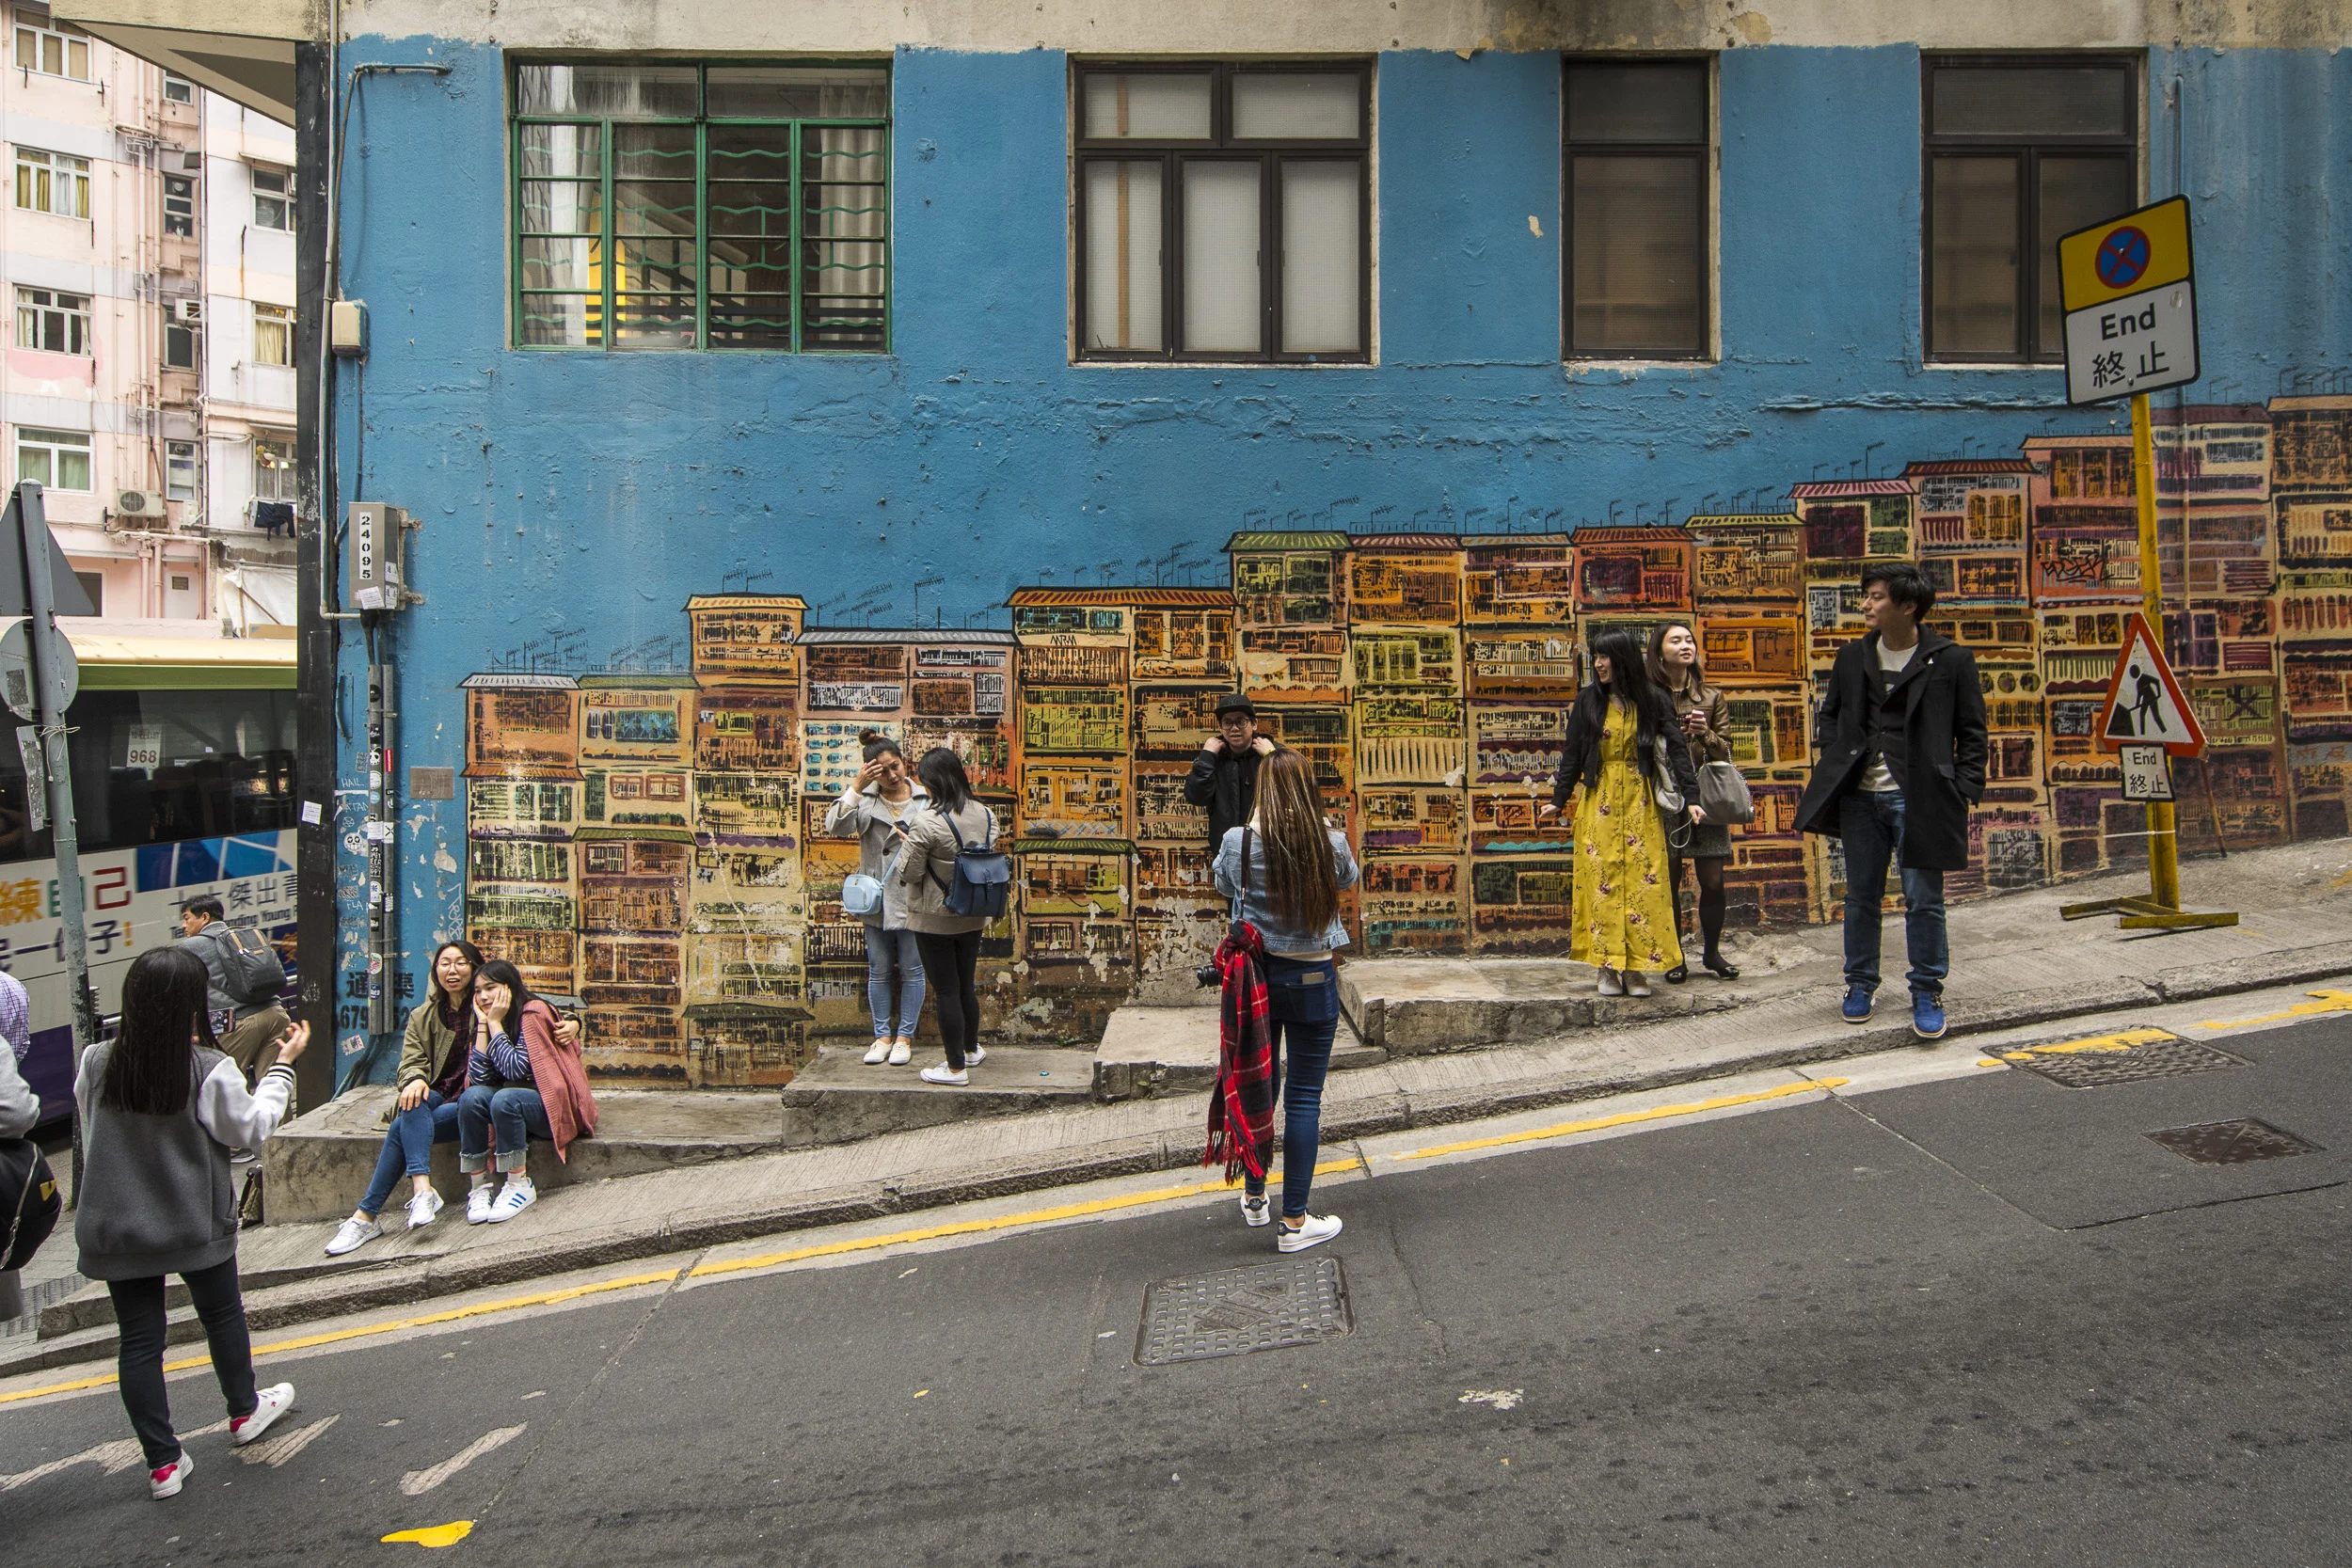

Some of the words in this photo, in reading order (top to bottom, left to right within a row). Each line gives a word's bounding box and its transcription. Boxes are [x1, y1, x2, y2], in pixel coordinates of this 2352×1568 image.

[2101, 302, 2156, 341] End
[2092, 341, 2169, 388] 終止
[361, 515, 372, 578] 24095
[130, 750, 157, 763] 968
[2133, 752, 2157, 765] End
[342, 777, 365, 788] HAIL
[2129, 773, 2168, 794] 終止
[345, 801, 369, 813] ATAN
[261, 908, 291, 923] Young
